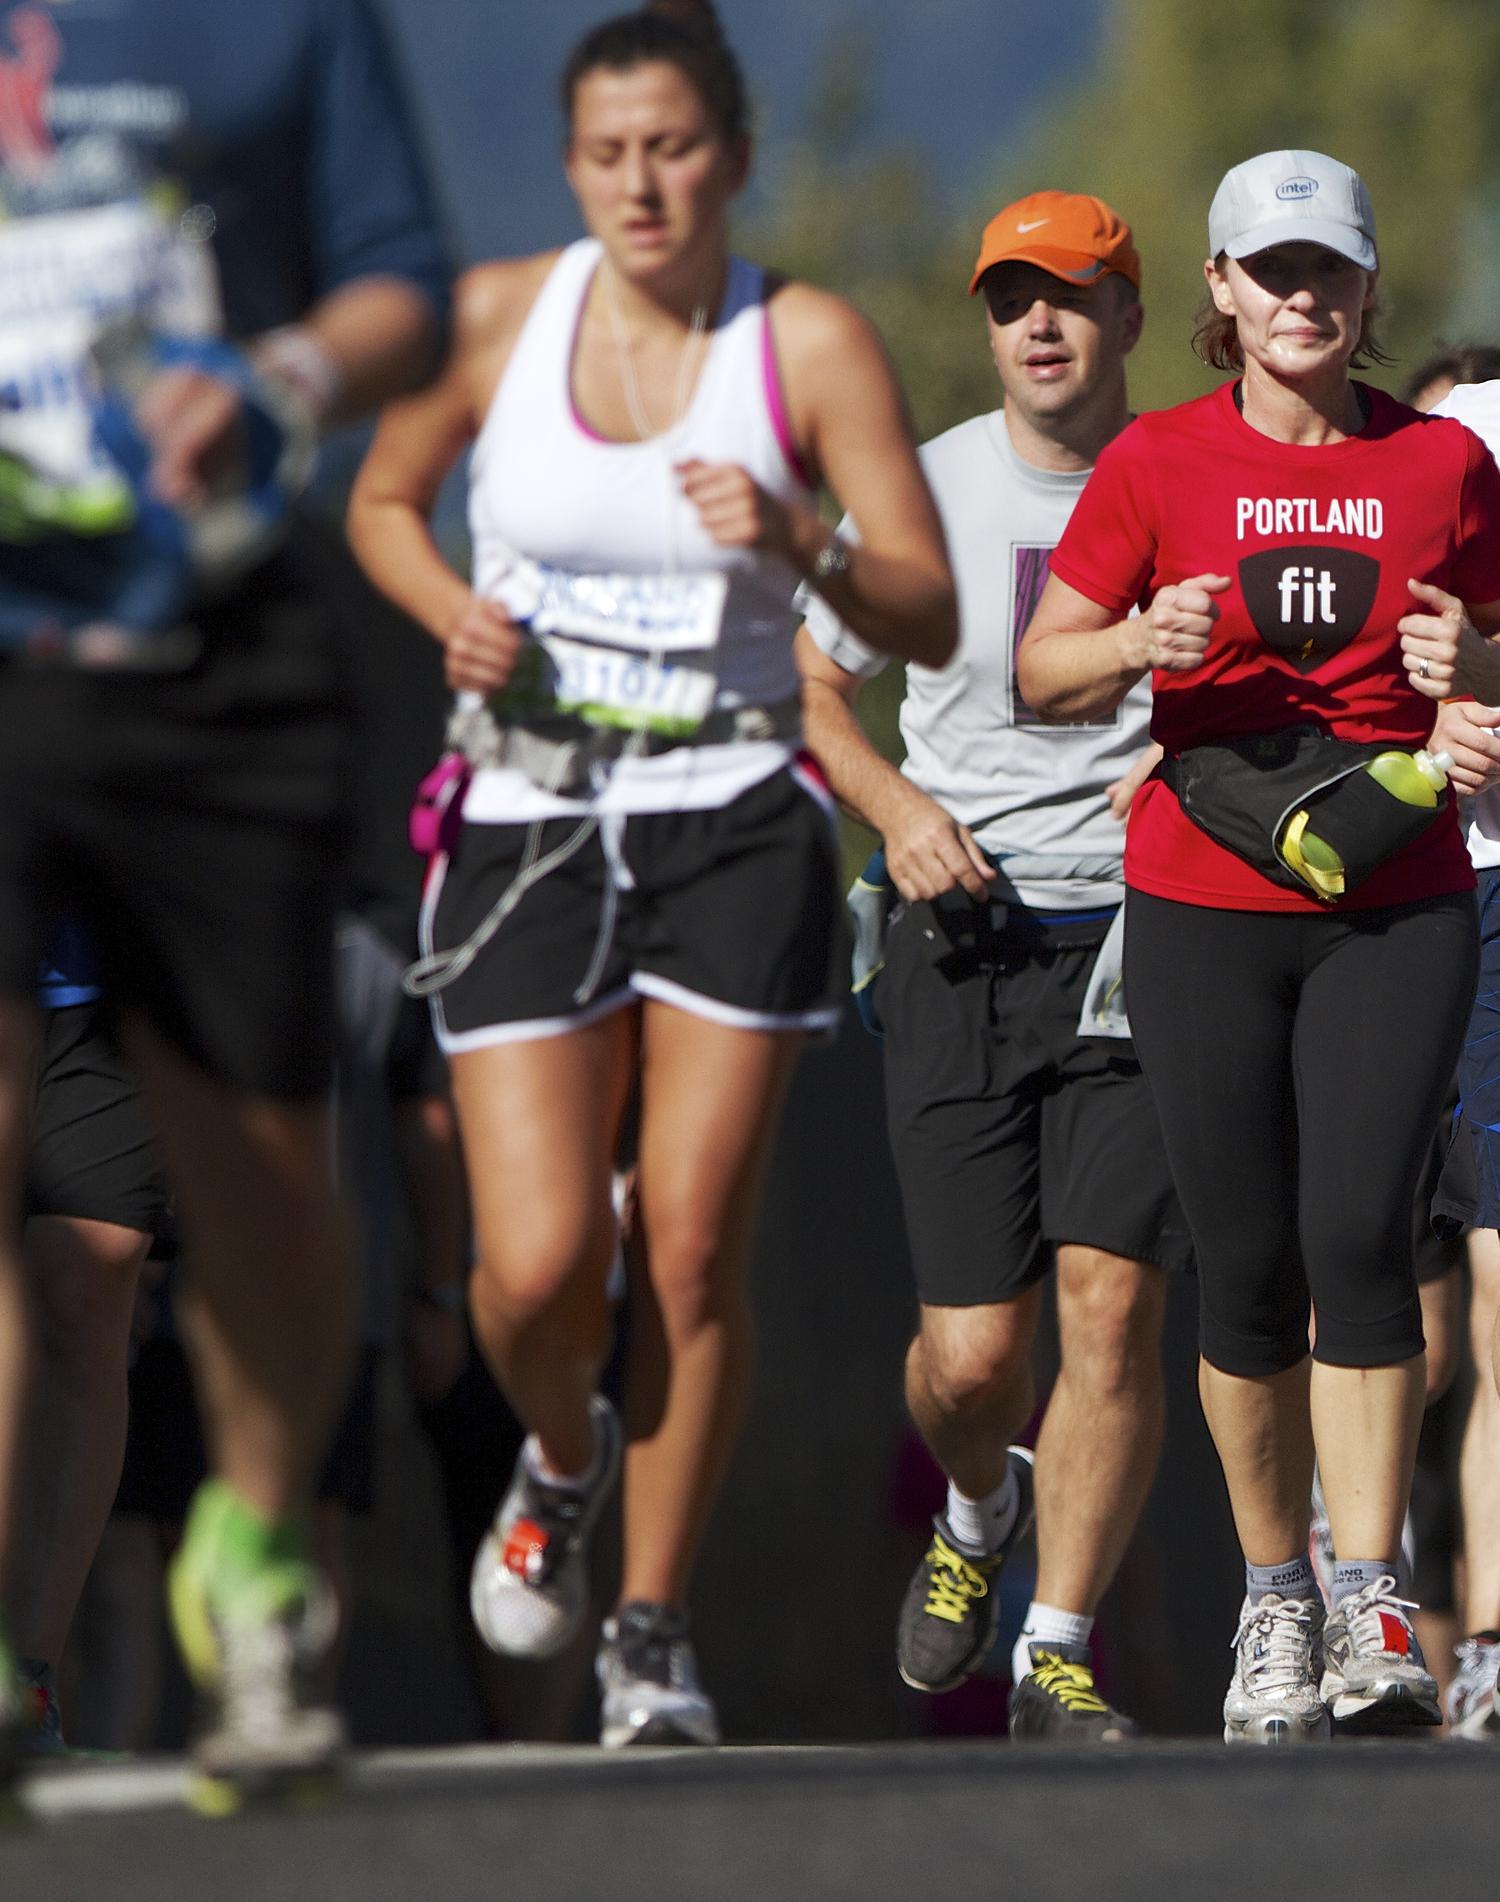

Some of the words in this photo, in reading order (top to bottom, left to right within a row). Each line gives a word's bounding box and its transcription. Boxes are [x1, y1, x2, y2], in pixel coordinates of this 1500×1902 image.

[1281, 182, 1312, 194] intel
[1237, 497, 1383, 540] PORTLAND
[1278, 566, 1336, 623] fit
